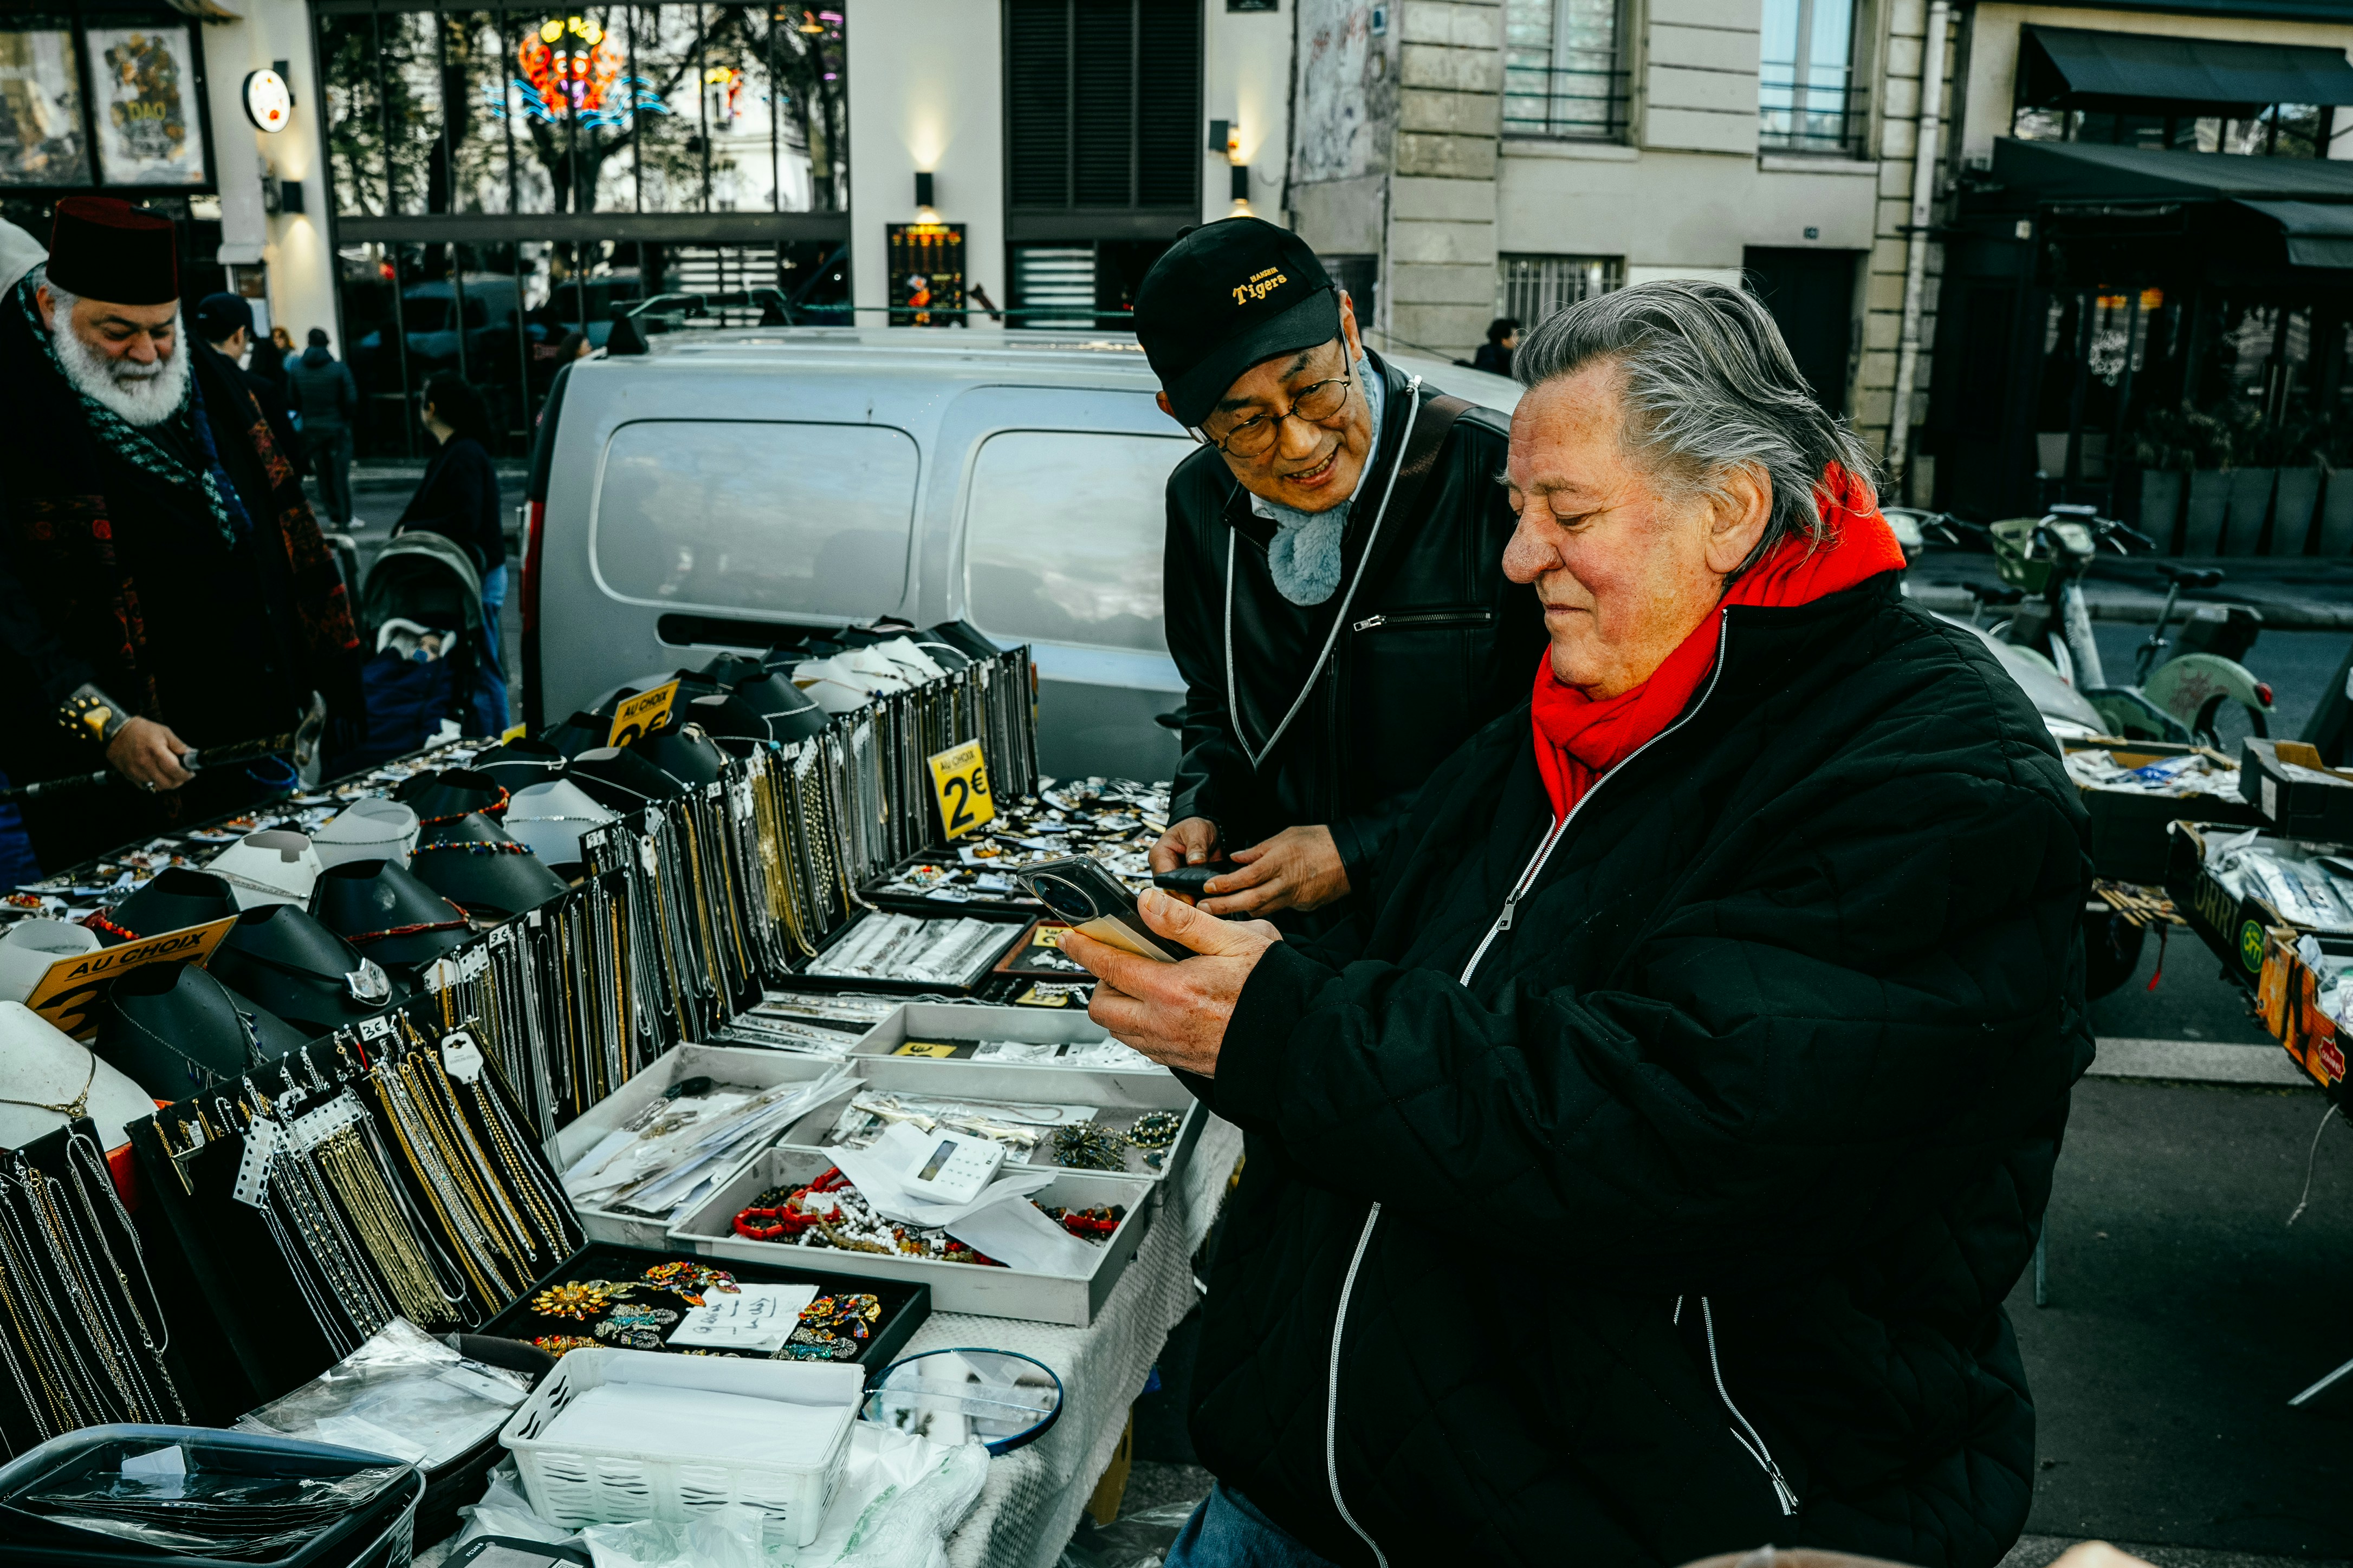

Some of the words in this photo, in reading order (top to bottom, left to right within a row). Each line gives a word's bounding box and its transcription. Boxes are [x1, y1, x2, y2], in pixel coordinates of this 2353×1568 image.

[1249, 266, 1279, 283] HANSHIN
[1233, 275, 1287, 305] Tigers
[623, 702, 639, 719] AU
[639, 689, 670, 711] CHOIX
[940, 759, 951, 771] AU
[952, 750, 976, 765] CHOIX
[944, 767, 987, 830] 2€
[491, 928, 509, 944] 3€
[67, 956, 114, 978] AU
[119, 931, 208, 964] CHOIX
[362, 1021, 383, 1039] 3€
[465, 1545, 481, 1557] FC340
